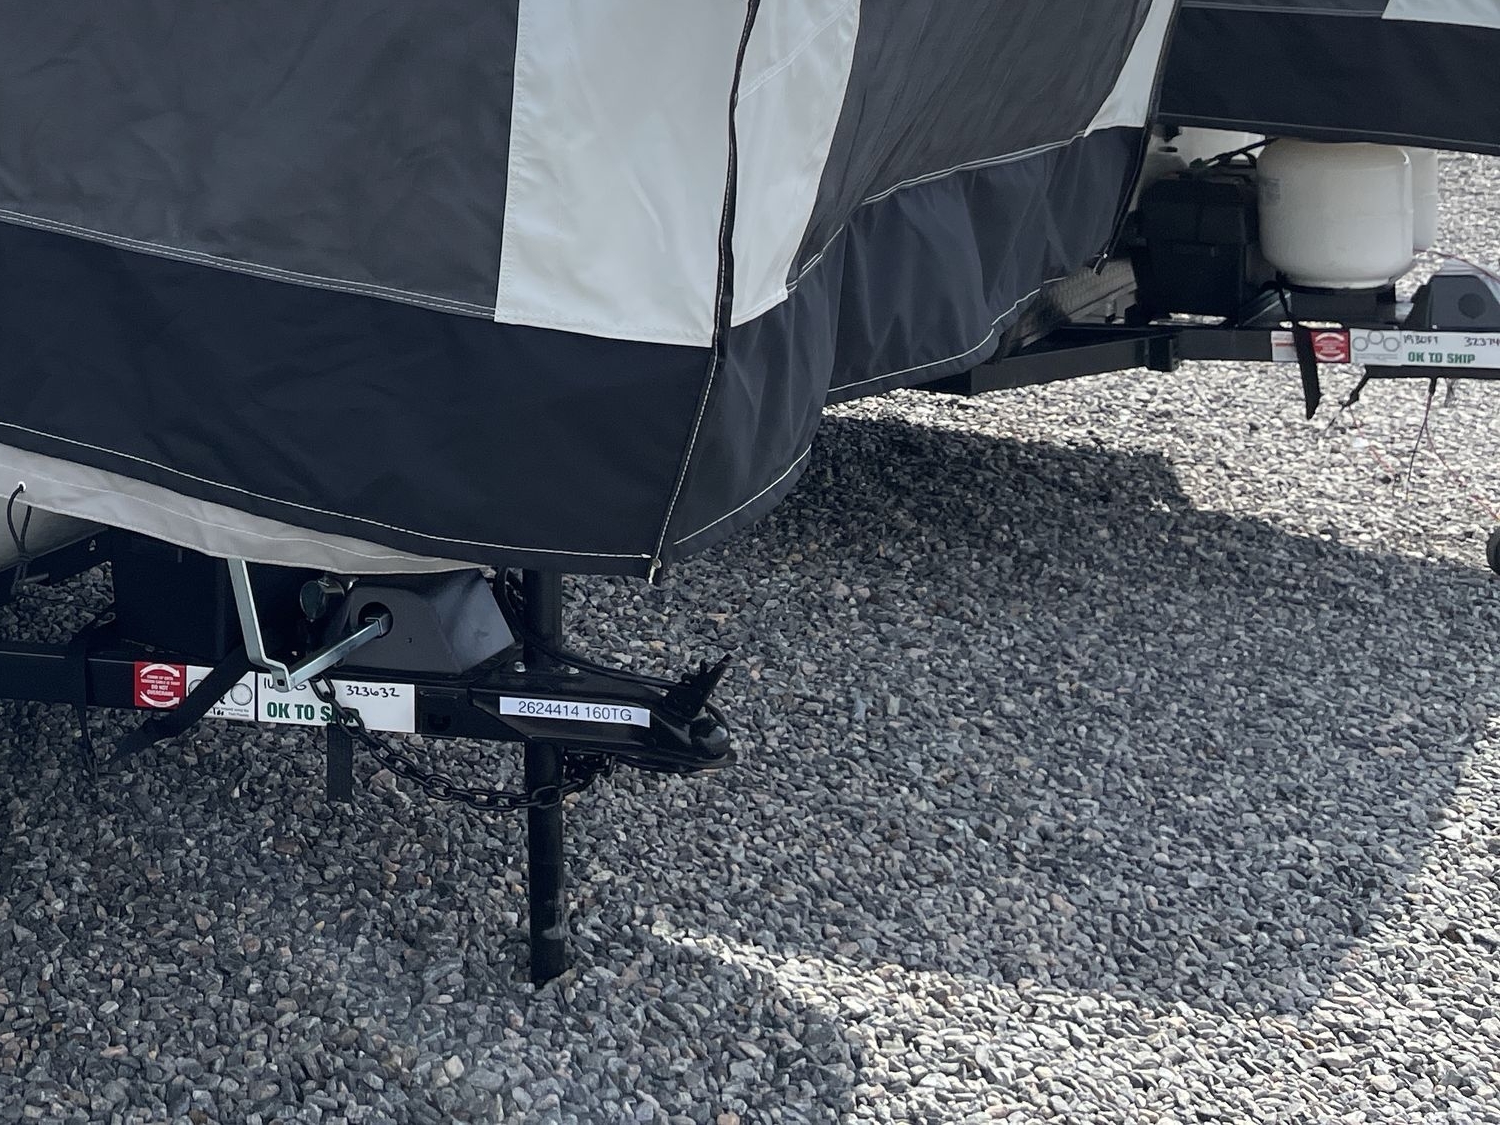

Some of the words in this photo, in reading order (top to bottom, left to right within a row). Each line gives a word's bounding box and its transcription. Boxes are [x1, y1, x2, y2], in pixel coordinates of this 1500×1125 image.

[1408, 351, 1425, 363] OK
[1428, 352, 1444, 364] TO
[1447, 353, 1476, 364] SHIP
[346, 684, 400, 698] 323632
[266, 701, 291, 719] OK
[294, 703, 315, 721] TO
[518, 700, 580, 717] 2624414
